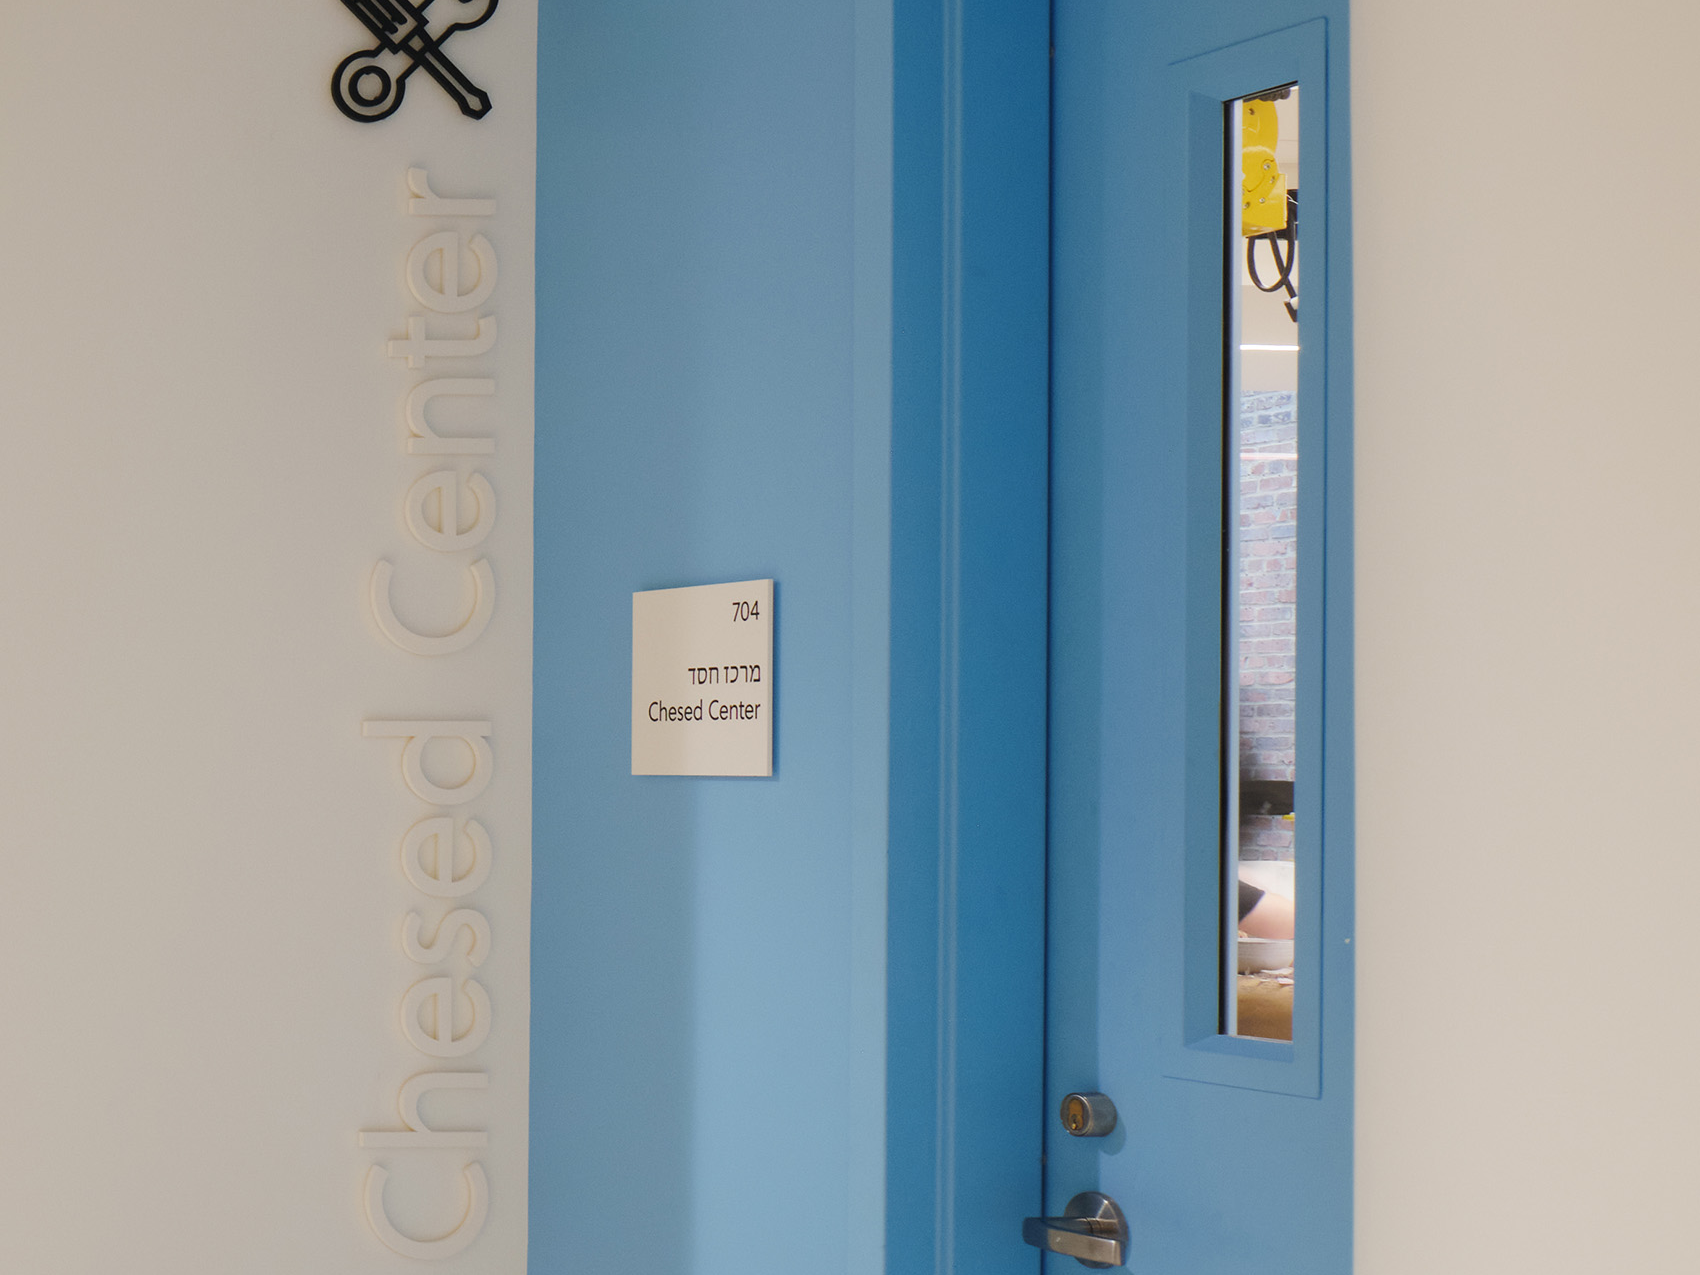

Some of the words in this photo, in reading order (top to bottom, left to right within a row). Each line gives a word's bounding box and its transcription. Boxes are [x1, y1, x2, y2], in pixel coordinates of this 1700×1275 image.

[366, 167, 499, 657] Center
[732, 601, 760, 622] 704
[688, 667, 719, 685] חסד
[724, 664, 761, 684] מרכז
[648, 699, 703, 722] Chesed
[708, 699, 761, 721] Center
[358, 718, 493, 1261] Chesed
